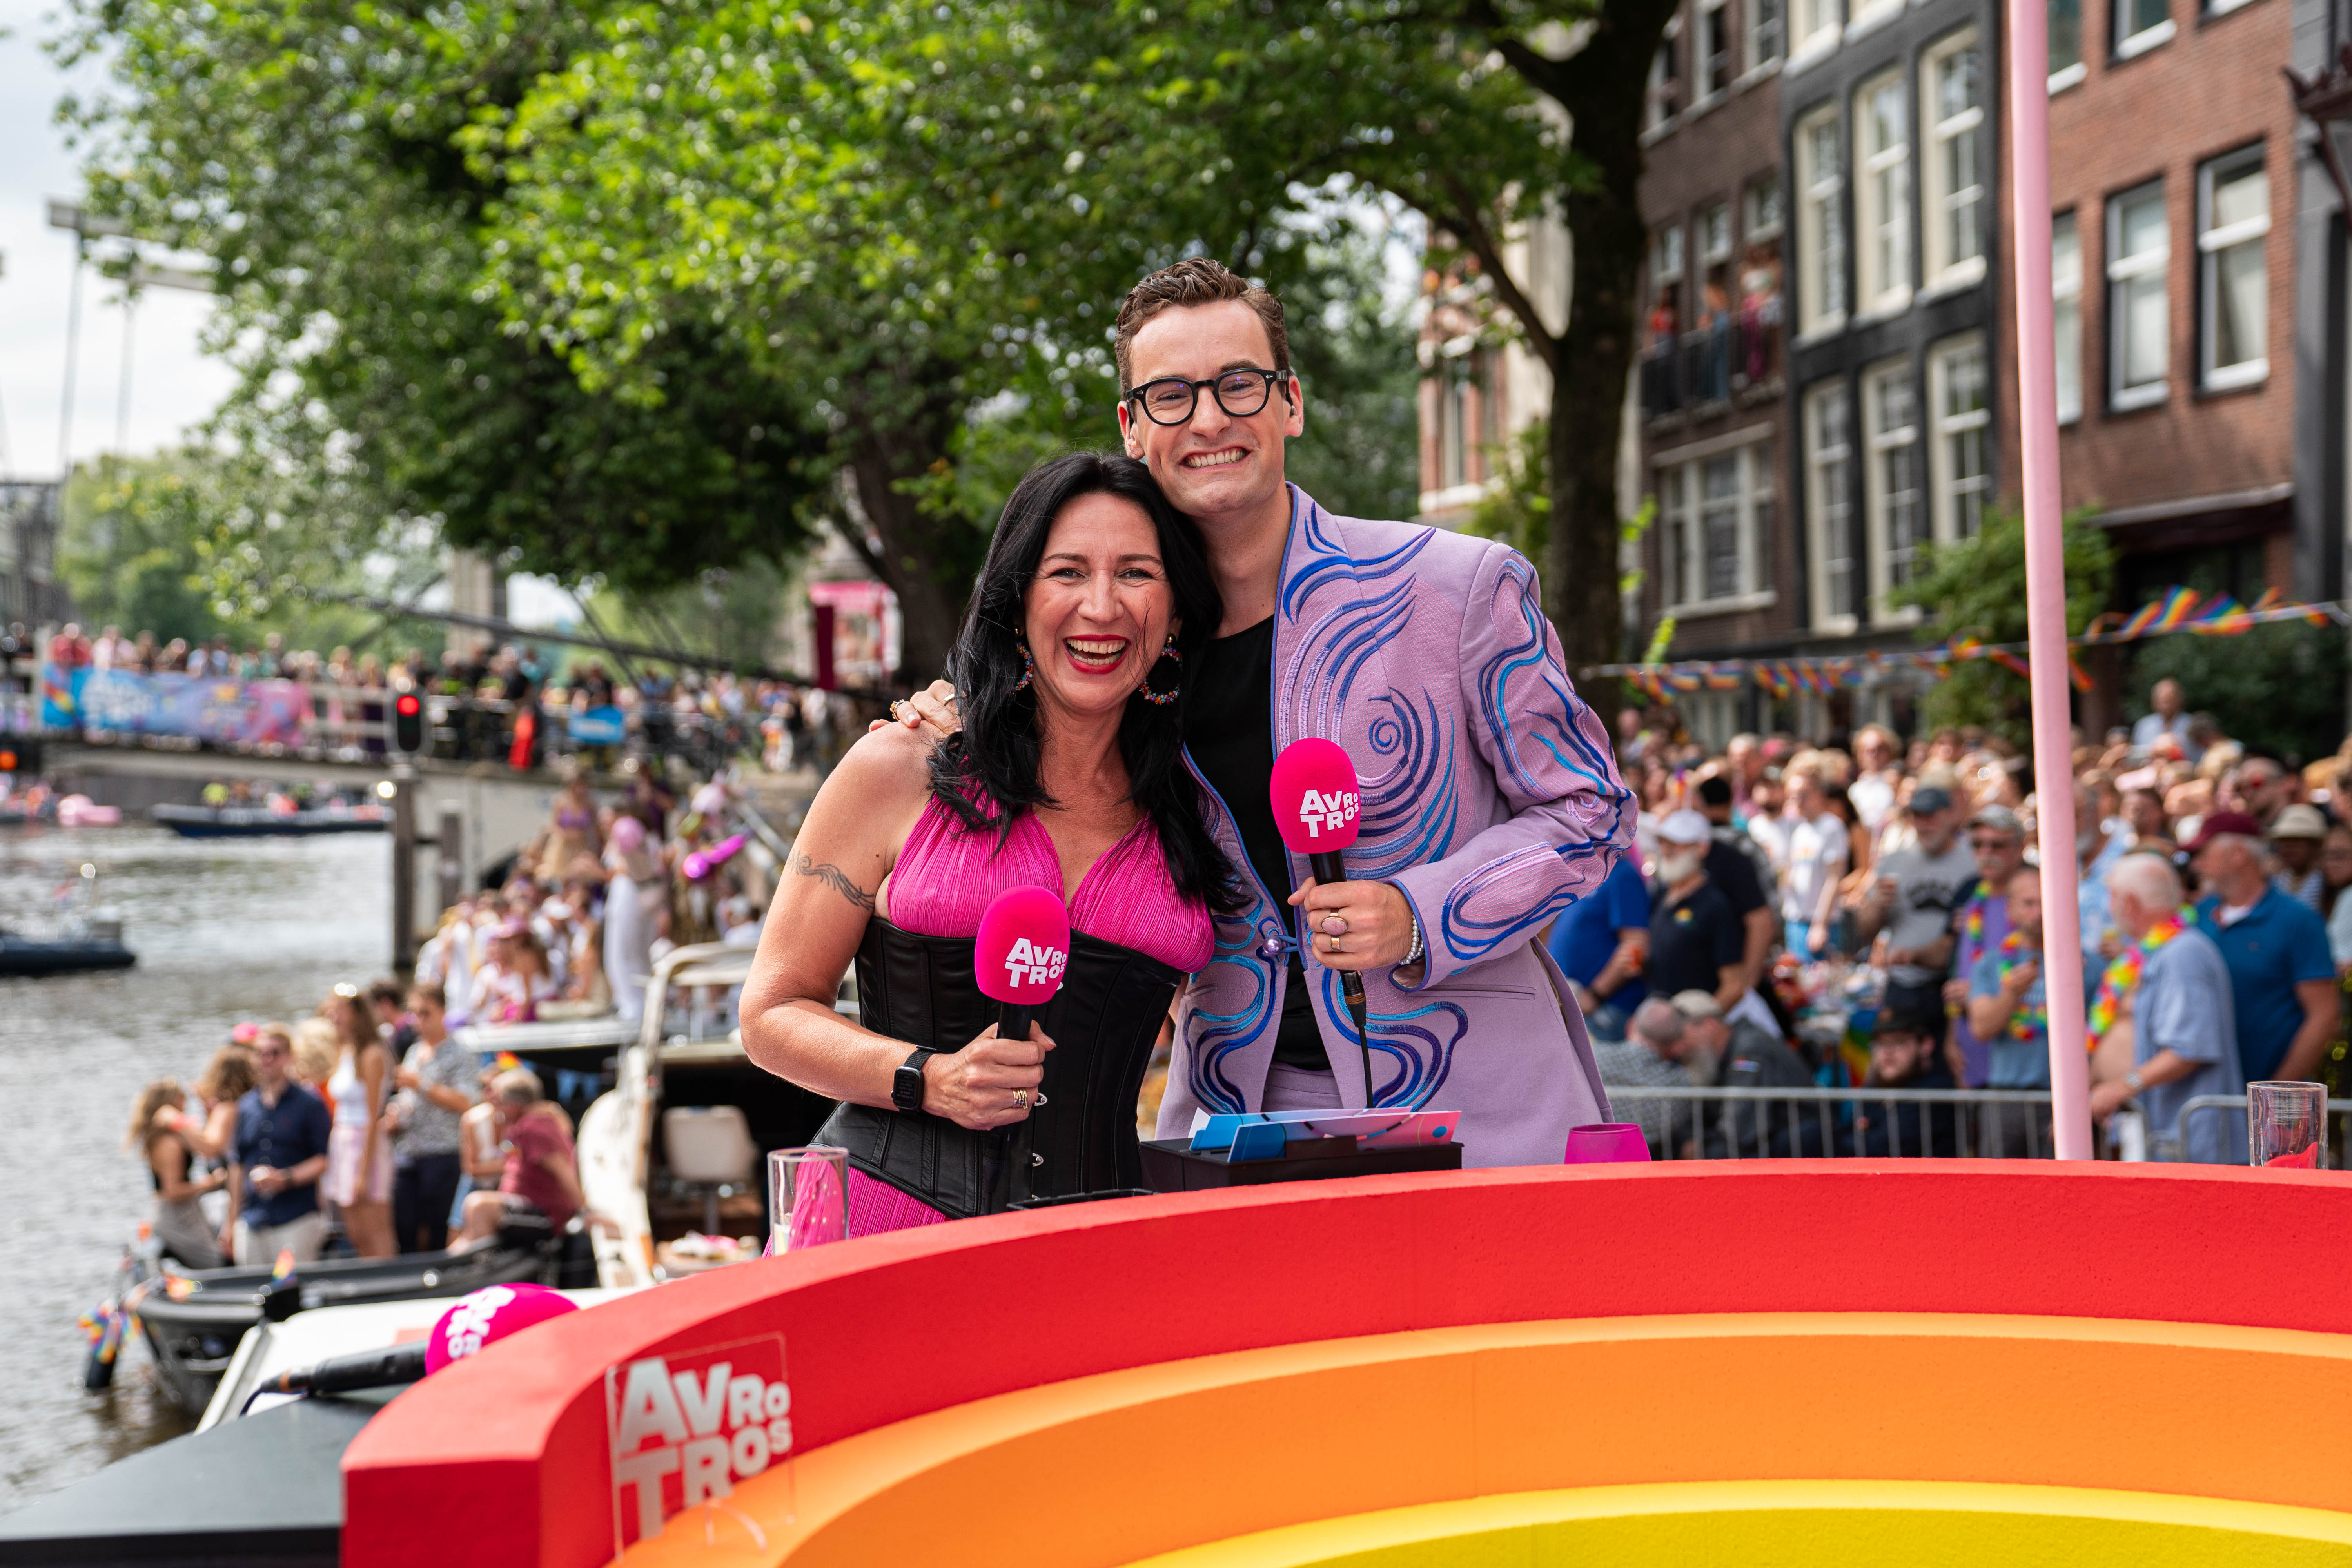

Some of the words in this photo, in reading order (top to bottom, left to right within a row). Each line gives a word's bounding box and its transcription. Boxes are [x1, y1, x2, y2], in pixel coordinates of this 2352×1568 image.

[1299, 789, 1358, 814] AVRO
[1300, 802, 1359, 837] TROS
[1006, 938, 1067, 965] AVRO
[1005, 961, 1065, 988] TROS
[617, 1356, 791, 1453] AVRO
[617, 1417, 793, 1541] TROS
